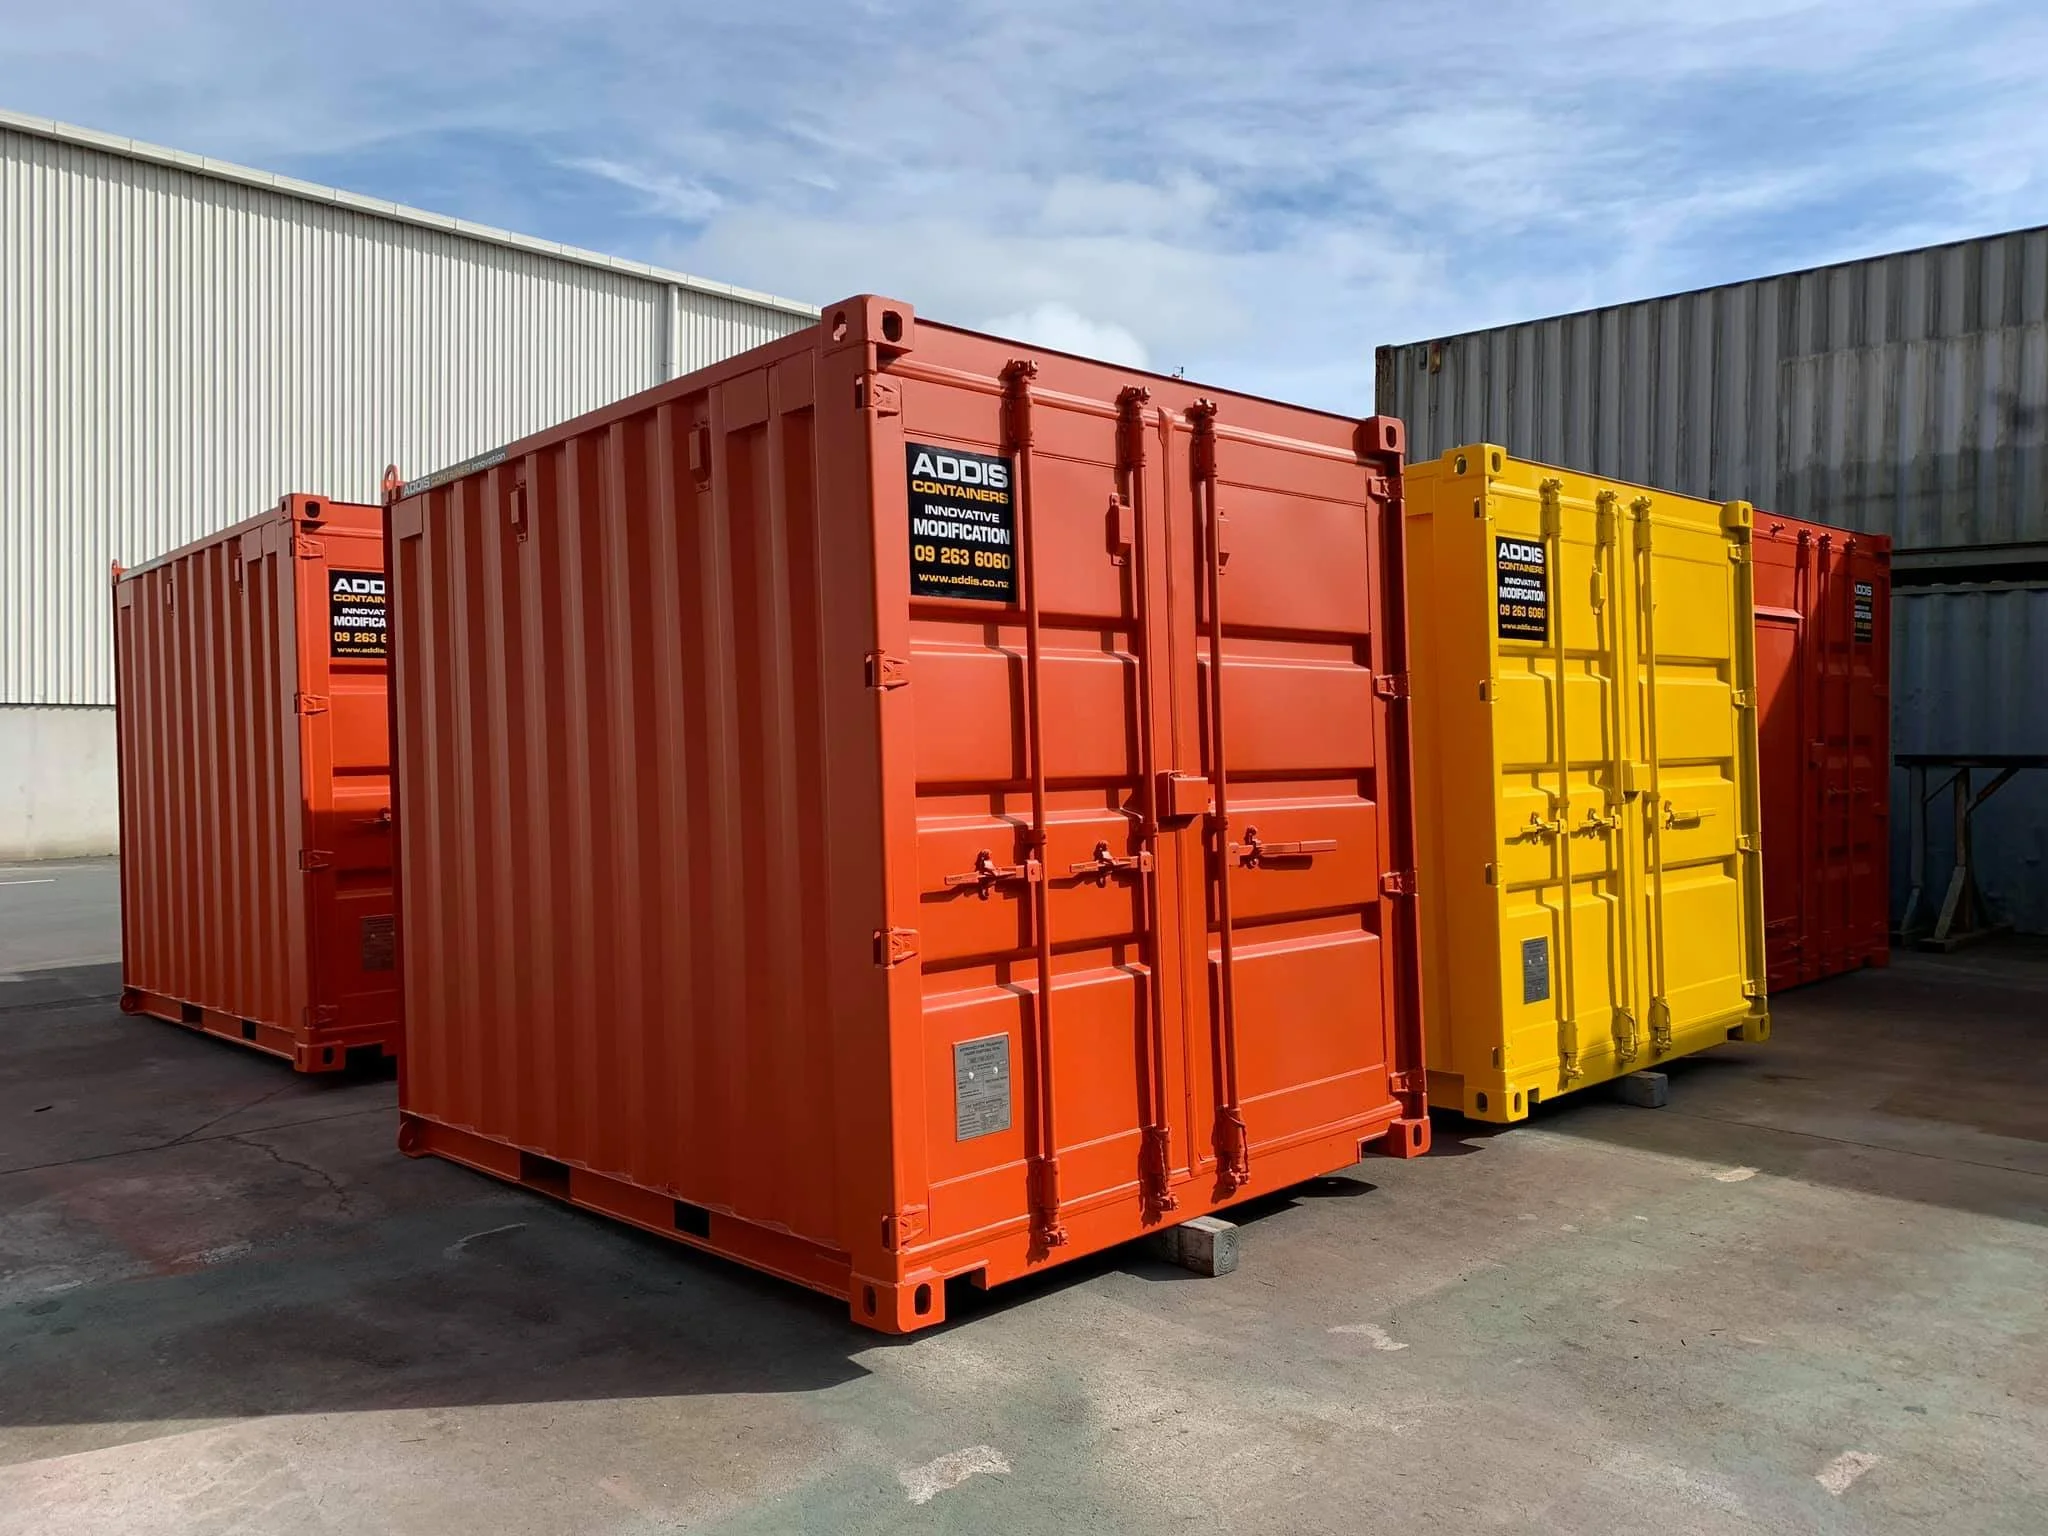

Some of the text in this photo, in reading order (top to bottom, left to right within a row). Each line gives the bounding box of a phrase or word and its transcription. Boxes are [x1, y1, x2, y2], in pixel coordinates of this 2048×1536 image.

[912, 452, 1008, 488] ADDIS
[403, 477, 430, 497] ADDIS
[912, 480, 1009, 504] CONTAINERS
[924, 504, 1000, 523] INNOVATIVE
[913, 518, 1010, 545] MODIFICATION
[914, 544, 1011, 570] 09 263 6060
[1498, 542, 1544, 564] ADDIS
[1498, 561, 1545, 575] CONTAINERS
[918, 573, 1009, 588] www.addis.co.nz
[1504, 577, 1541, 588] INNOVATIVE
[1499, 586, 1546, 602] MODIFICATION
[1854, 584, 1872, 596] DDIS
[1499, 603, 1546, 619] 09 263 6060
[333, 615, 387, 628] MODIFICA
[334, 631, 350, 642] 09
[354, 632, 377, 643] 263
